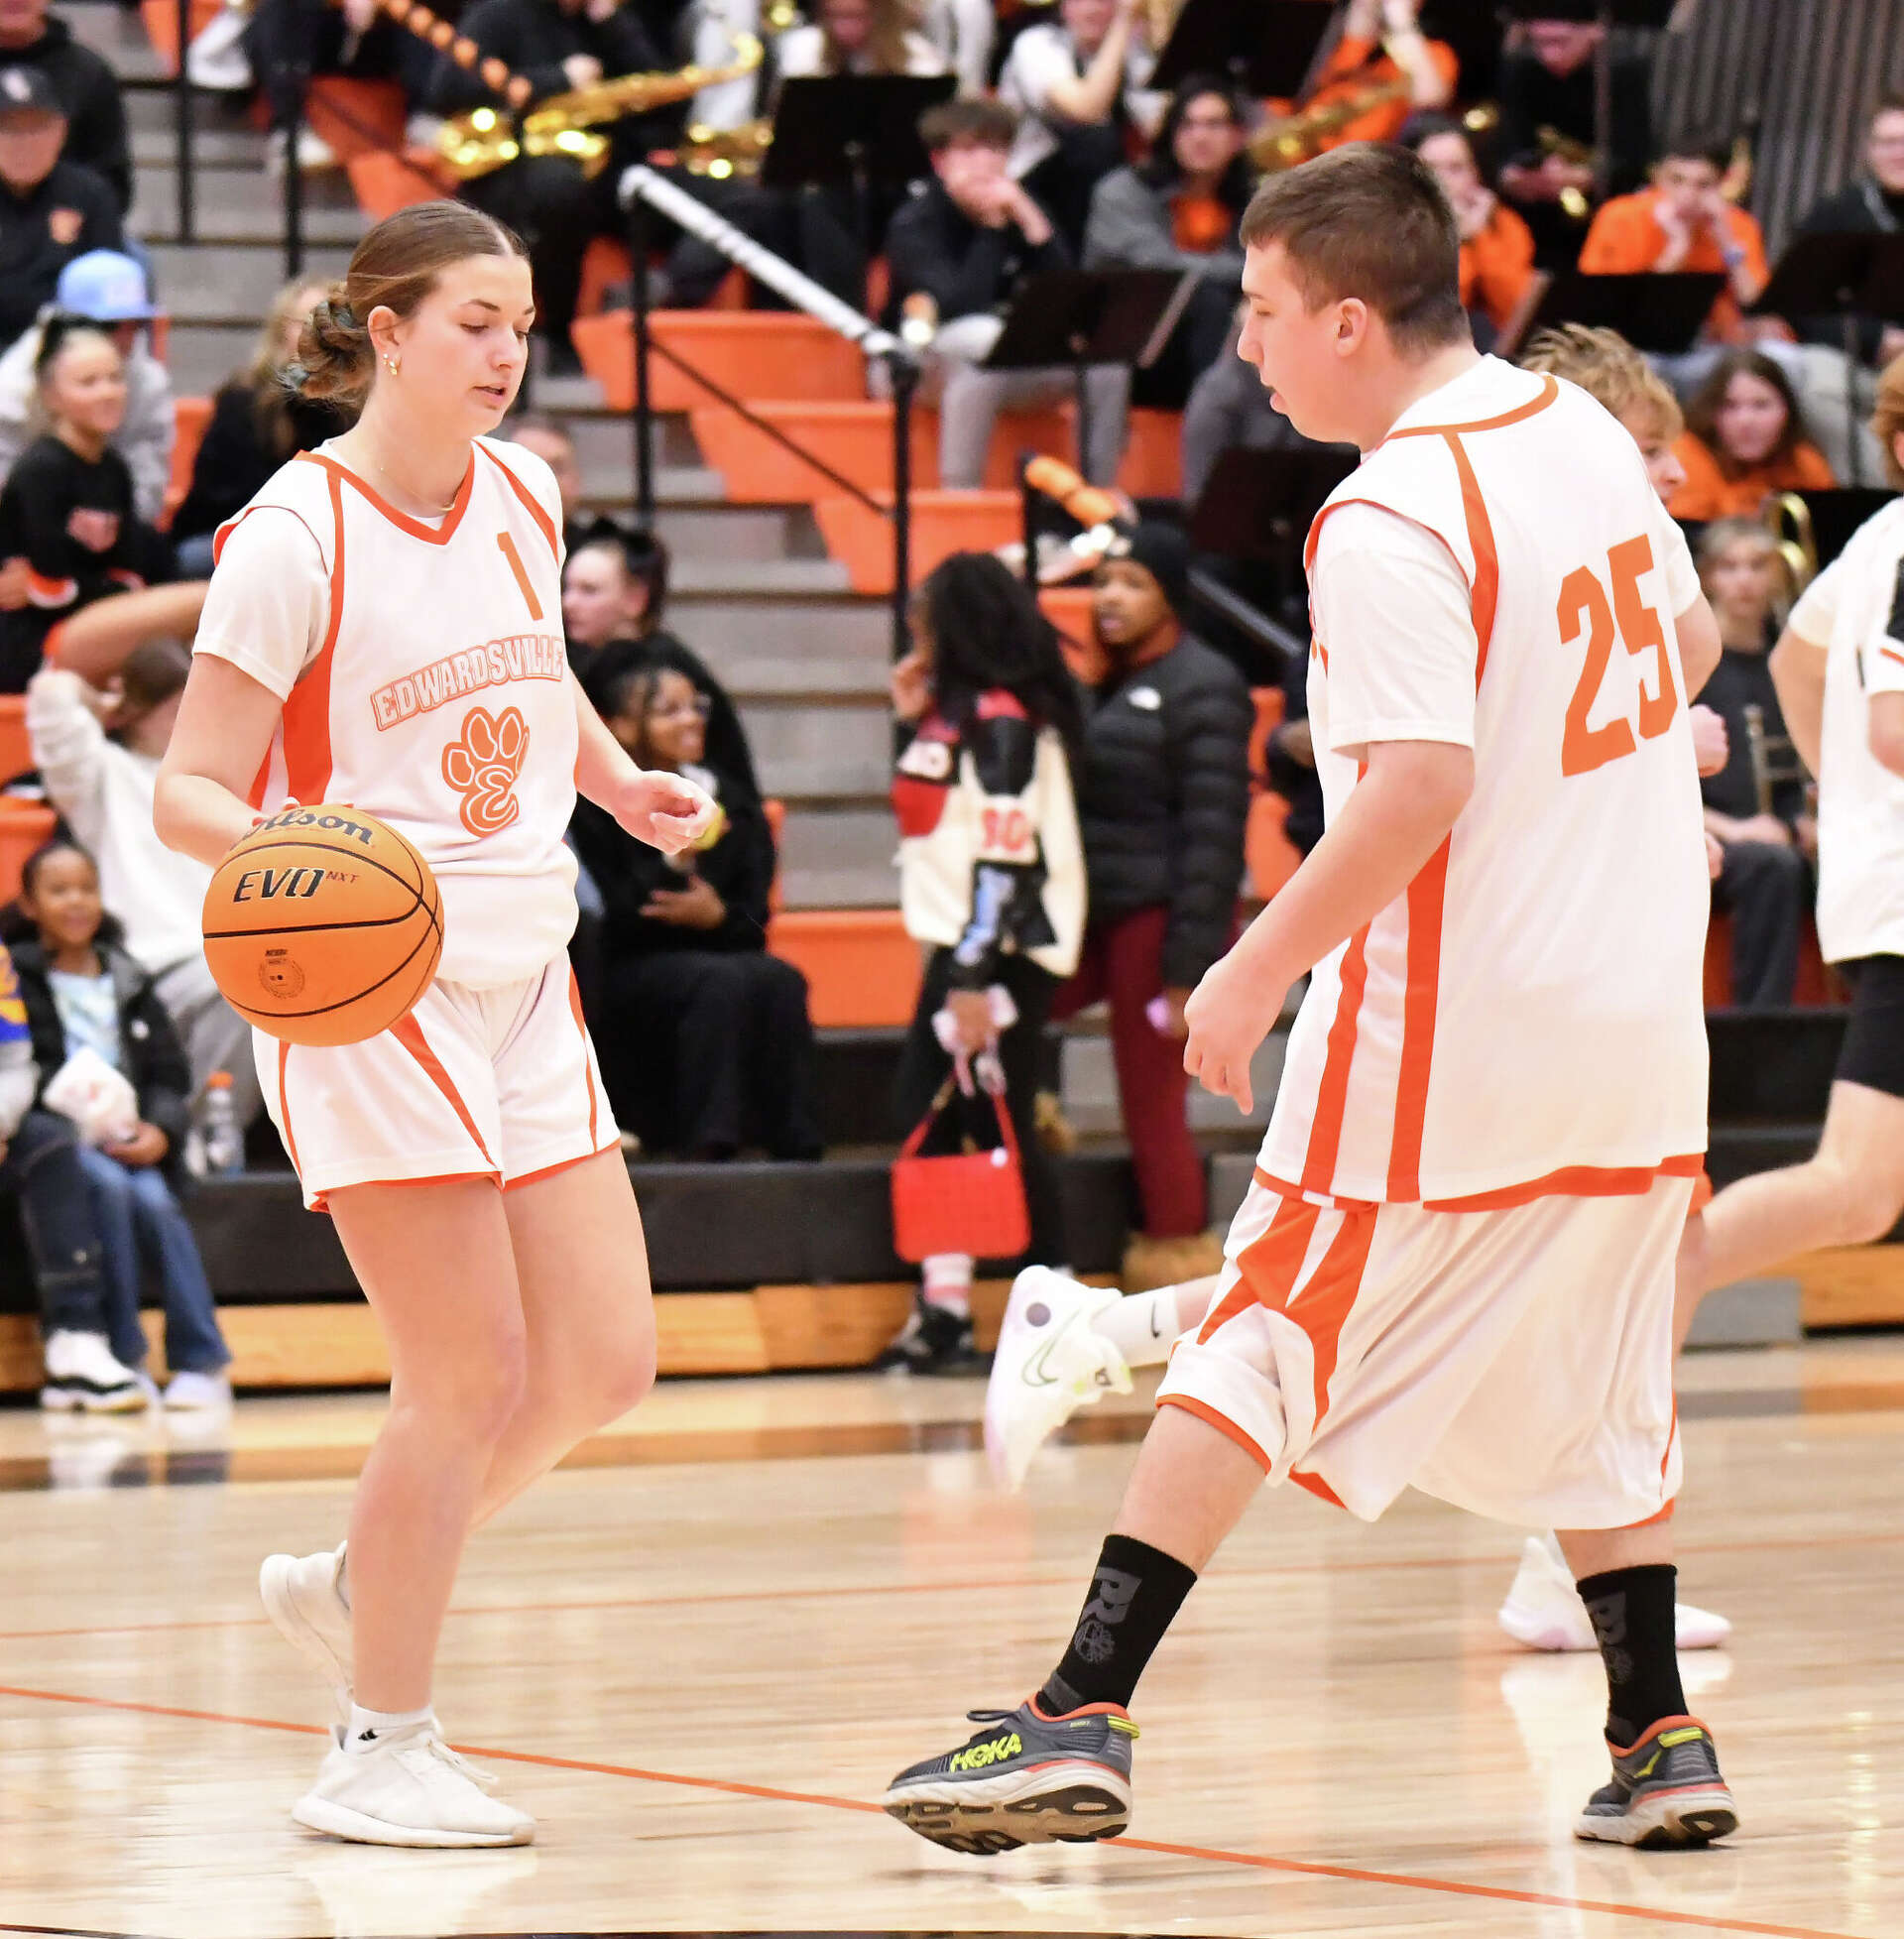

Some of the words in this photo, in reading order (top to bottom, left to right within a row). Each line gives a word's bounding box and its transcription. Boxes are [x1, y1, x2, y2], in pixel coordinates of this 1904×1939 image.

[497, 531, 543, 621] 1
[370, 634, 564, 732] EDWARDSVILLE
[1556, 533, 1678, 778] 25
[232, 867, 326, 904] EVO
[325, 870, 360, 884] NXT
[949, 1733, 1022, 1773] HOKA
